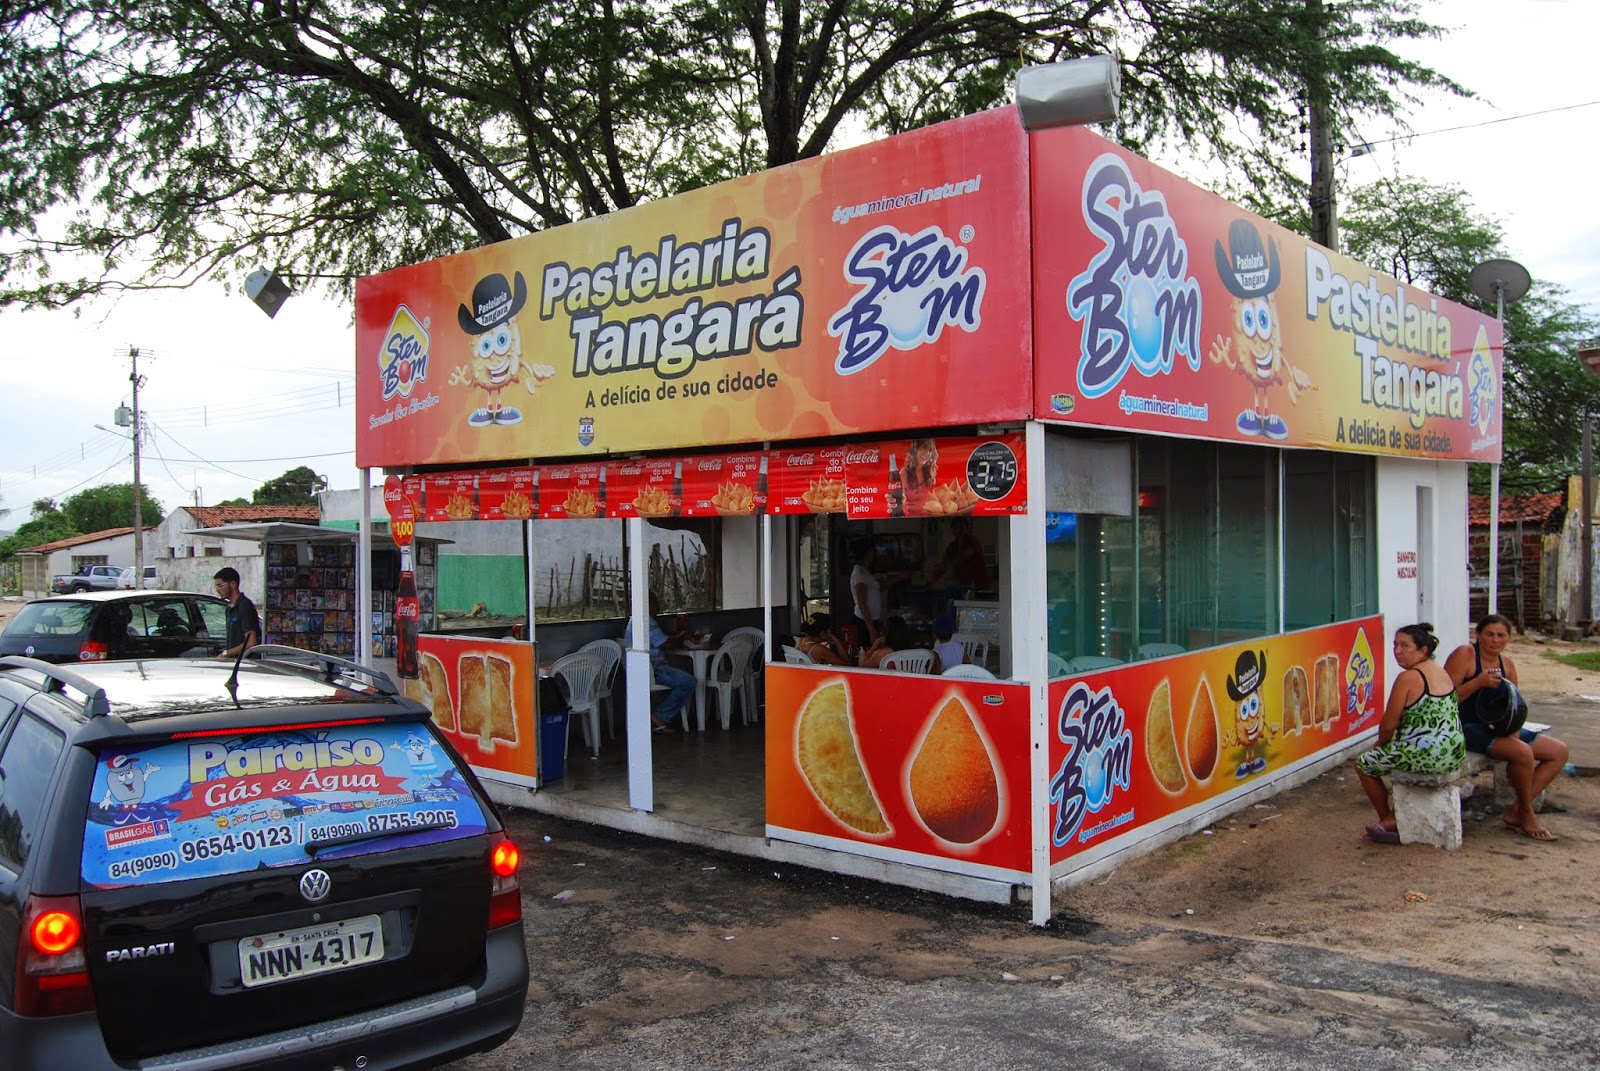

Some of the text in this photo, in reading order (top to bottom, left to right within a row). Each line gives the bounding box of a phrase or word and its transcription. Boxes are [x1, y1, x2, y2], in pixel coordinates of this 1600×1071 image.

[1086, 164, 1184, 281] Ster
[540, 217, 771, 321] Pastelaria
[848, 231, 963, 303] Ster
[1236, 252, 1264, 270] Pastelaria
[478, 291, 507, 315] Pastelaria
[1306, 245, 1453, 361] Pastelaria
[570, 265, 804, 379] Tangará
[387, 332, 422, 364] Ster
[584, 367, 779, 409] A delícia de sua cidade
[1354, 335, 1464, 429] Tangará
[1336, 416, 1346, 443] A
[1349, 419, 1386, 447] delícia
[1389, 425, 1402, 449] de
[1404, 432, 1421, 451] sua
[698, 459, 722, 471] Coca-Cola
[727, 455, 756, 463] Combine
[735, 463, 744, 471] do
[787, 453, 814, 466] Coca-Cola
[846, 449, 880, 464] Coca-Cola
[731, 470, 746, 479] jeito
[826, 466, 842, 474] jeito
[846, 486, 878, 494] Combine
[849, 495, 859, 503] do
[852, 505, 870, 513] jeito
[395, 521, 414, 538] 1,00
[1061, 688, 1122, 766] Ster
[188, 732, 385, 784] Paraíso
[204, 776, 262, 807] Gás
[271, 777, 292, 794] &
[299, 768, 381, 796] Água
[109, 825, 154, 842] BRASILGÁS
[112, 851, 177, 878] 84(9090)
[182, 826, 293, 863] 9654-0123
[303, 932, 322, 940] SANTA
[323, 928, 340, 937] CRUZ
[106, 942, 176, 963] PARATI
[250, 931, 375, 980] NNN-4317
